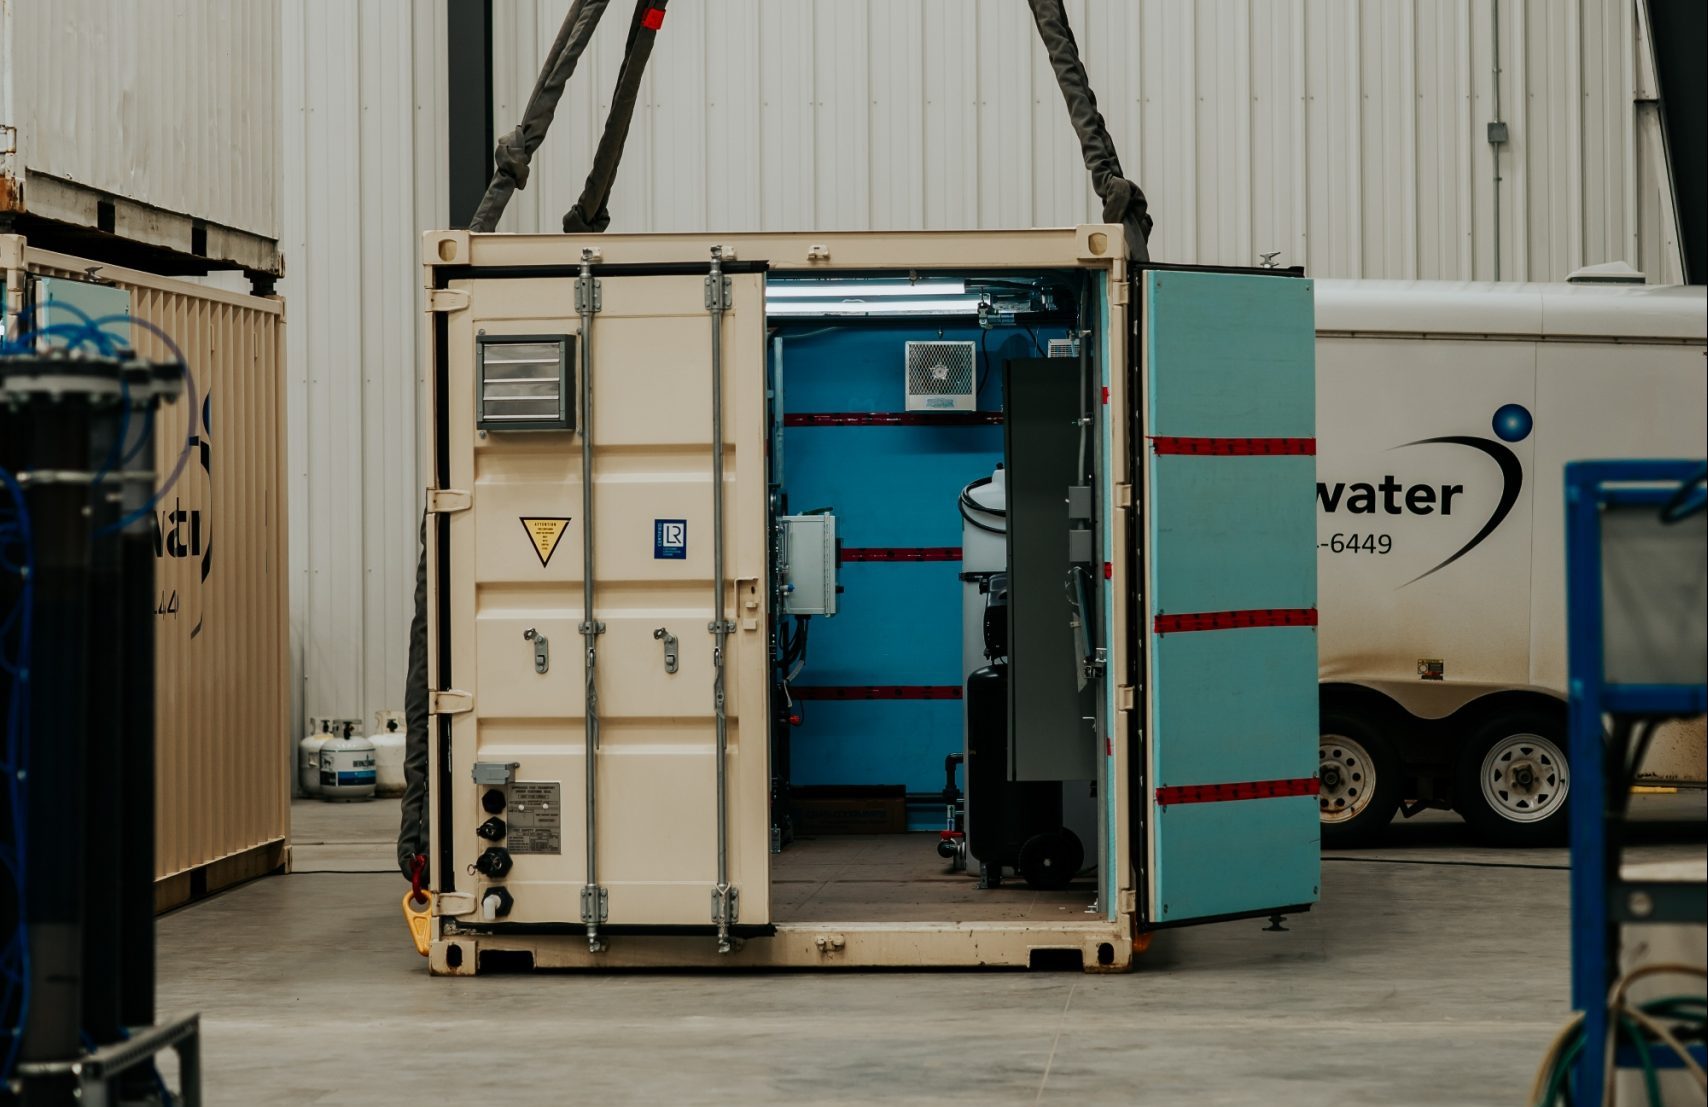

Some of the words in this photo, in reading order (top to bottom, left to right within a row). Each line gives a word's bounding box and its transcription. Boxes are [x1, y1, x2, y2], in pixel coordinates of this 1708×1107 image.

[1316, 475, 1463, 515] water
[666, 525, 682, 544] LR
[1317, 533, 1392, 554] -6449
